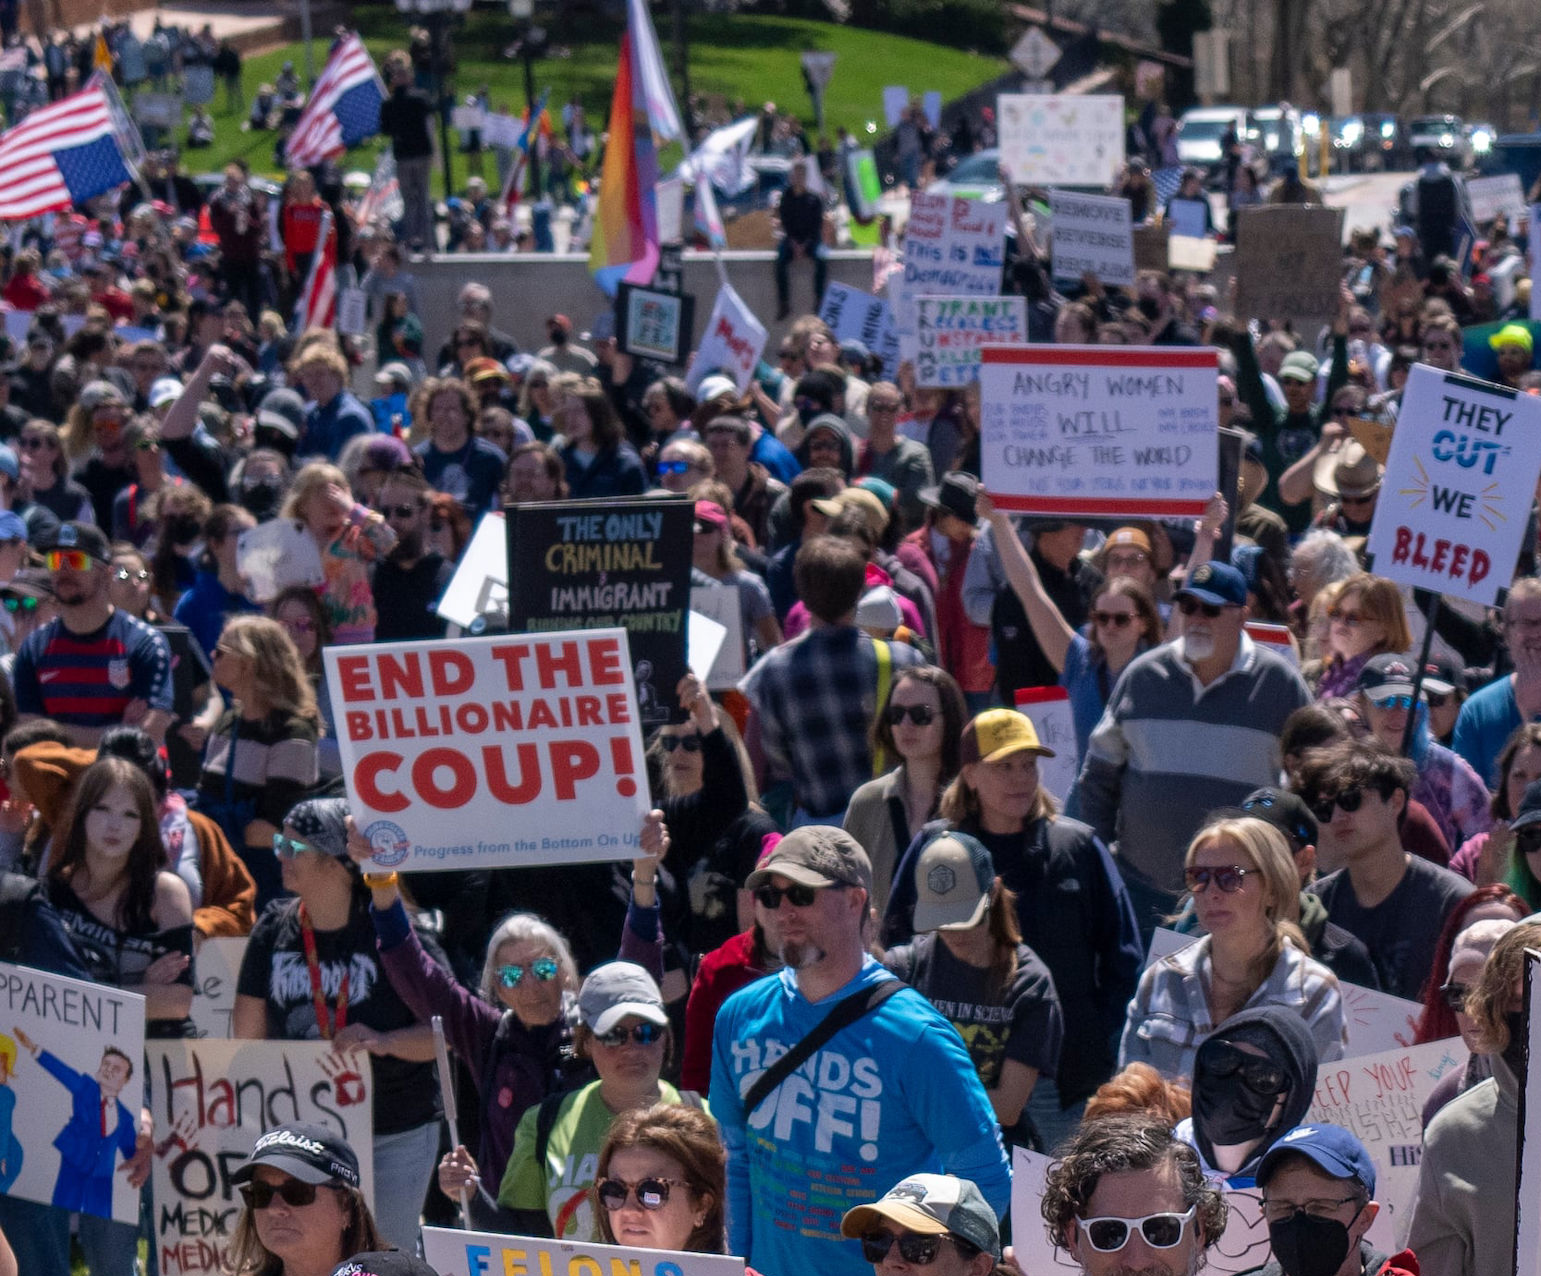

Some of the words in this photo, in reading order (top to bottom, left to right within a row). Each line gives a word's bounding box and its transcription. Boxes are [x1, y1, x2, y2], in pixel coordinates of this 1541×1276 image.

[1013, 371, 1090, 399] ANGRY
[1106, 374, 1184, 398] WOMEN
[1056, 410, 1137, 435] WILL
[1442, 396, 1512, 435] THEY
[1003, 445, 1078, 469] CHANGE
[1091, 446, 1126, 465] THE
[1134, 445, 1192, 466] WORLD
[1432, 429, 1508, 475] CUT
[1432, 485, 1476, 519] WE
[556, 515, 604, 542] THE
[605, 512, 663, 541] ONLY
[545, 542, 663, 574] CRIMINAL
[1392, 525, 1490, 588] BLEED
[551, 582, 673, 611] IMMIGRANT
[337, 649, 475, 702] END
[492, 638, 624, 692] THE
[346, 693, 631, 741] BILLIONAIRE
[354, 737, 637, 813] COUP!
[414, 844, 474, 859] Progress
[478, 841, 510, 854] from
[514, 839, 537, 851] the
[541, 835, 592, 850] Bottom
[598, 834, 618, 847] On
[161, 1050, 348, 1140] Hands
[1362, 1056, 1417, 1098] YOUR
